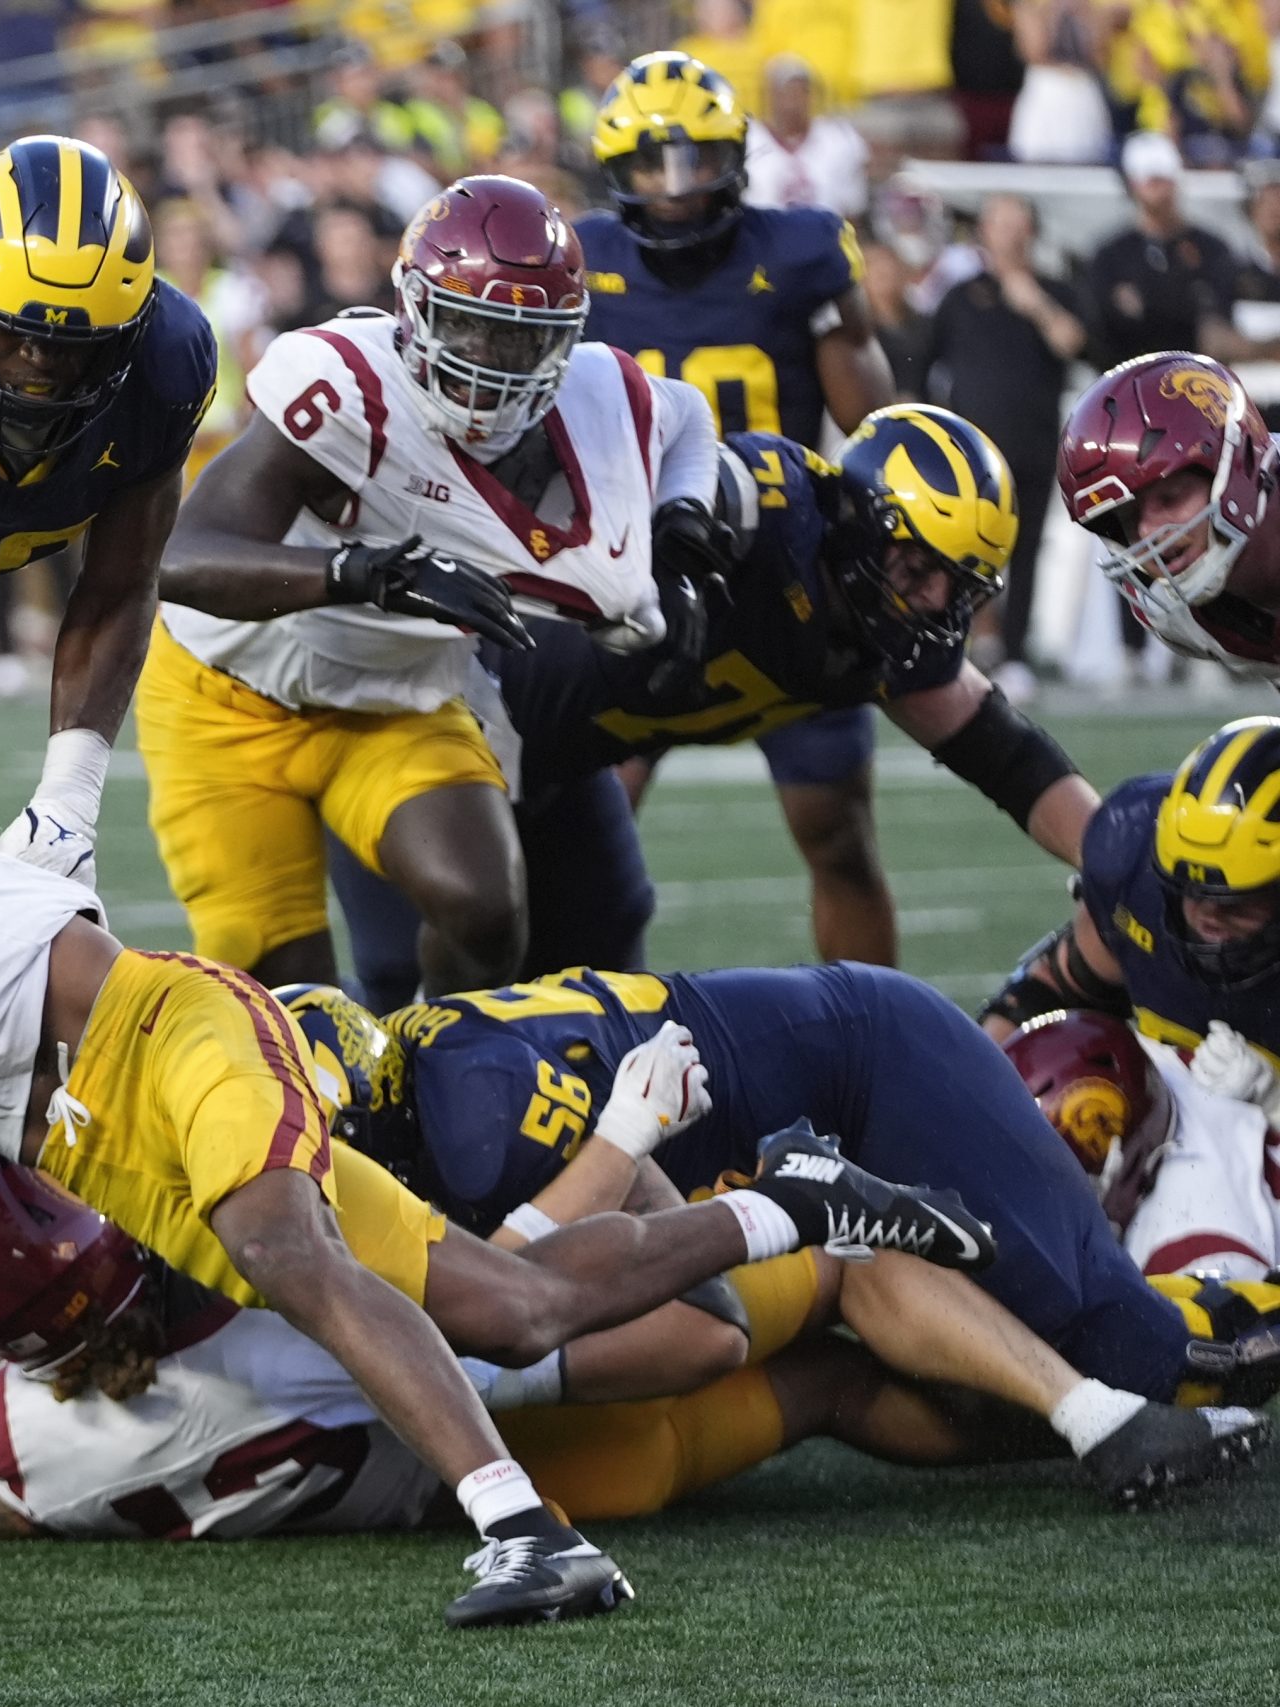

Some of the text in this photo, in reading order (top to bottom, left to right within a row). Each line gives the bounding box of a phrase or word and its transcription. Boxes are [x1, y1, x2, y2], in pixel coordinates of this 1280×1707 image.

[44, 308, 68, 325] M
[284, 379, 340, 441] 6
[520, 1059, 592, 1161] 56
[775, 1152, 846, 1185] NIKE
